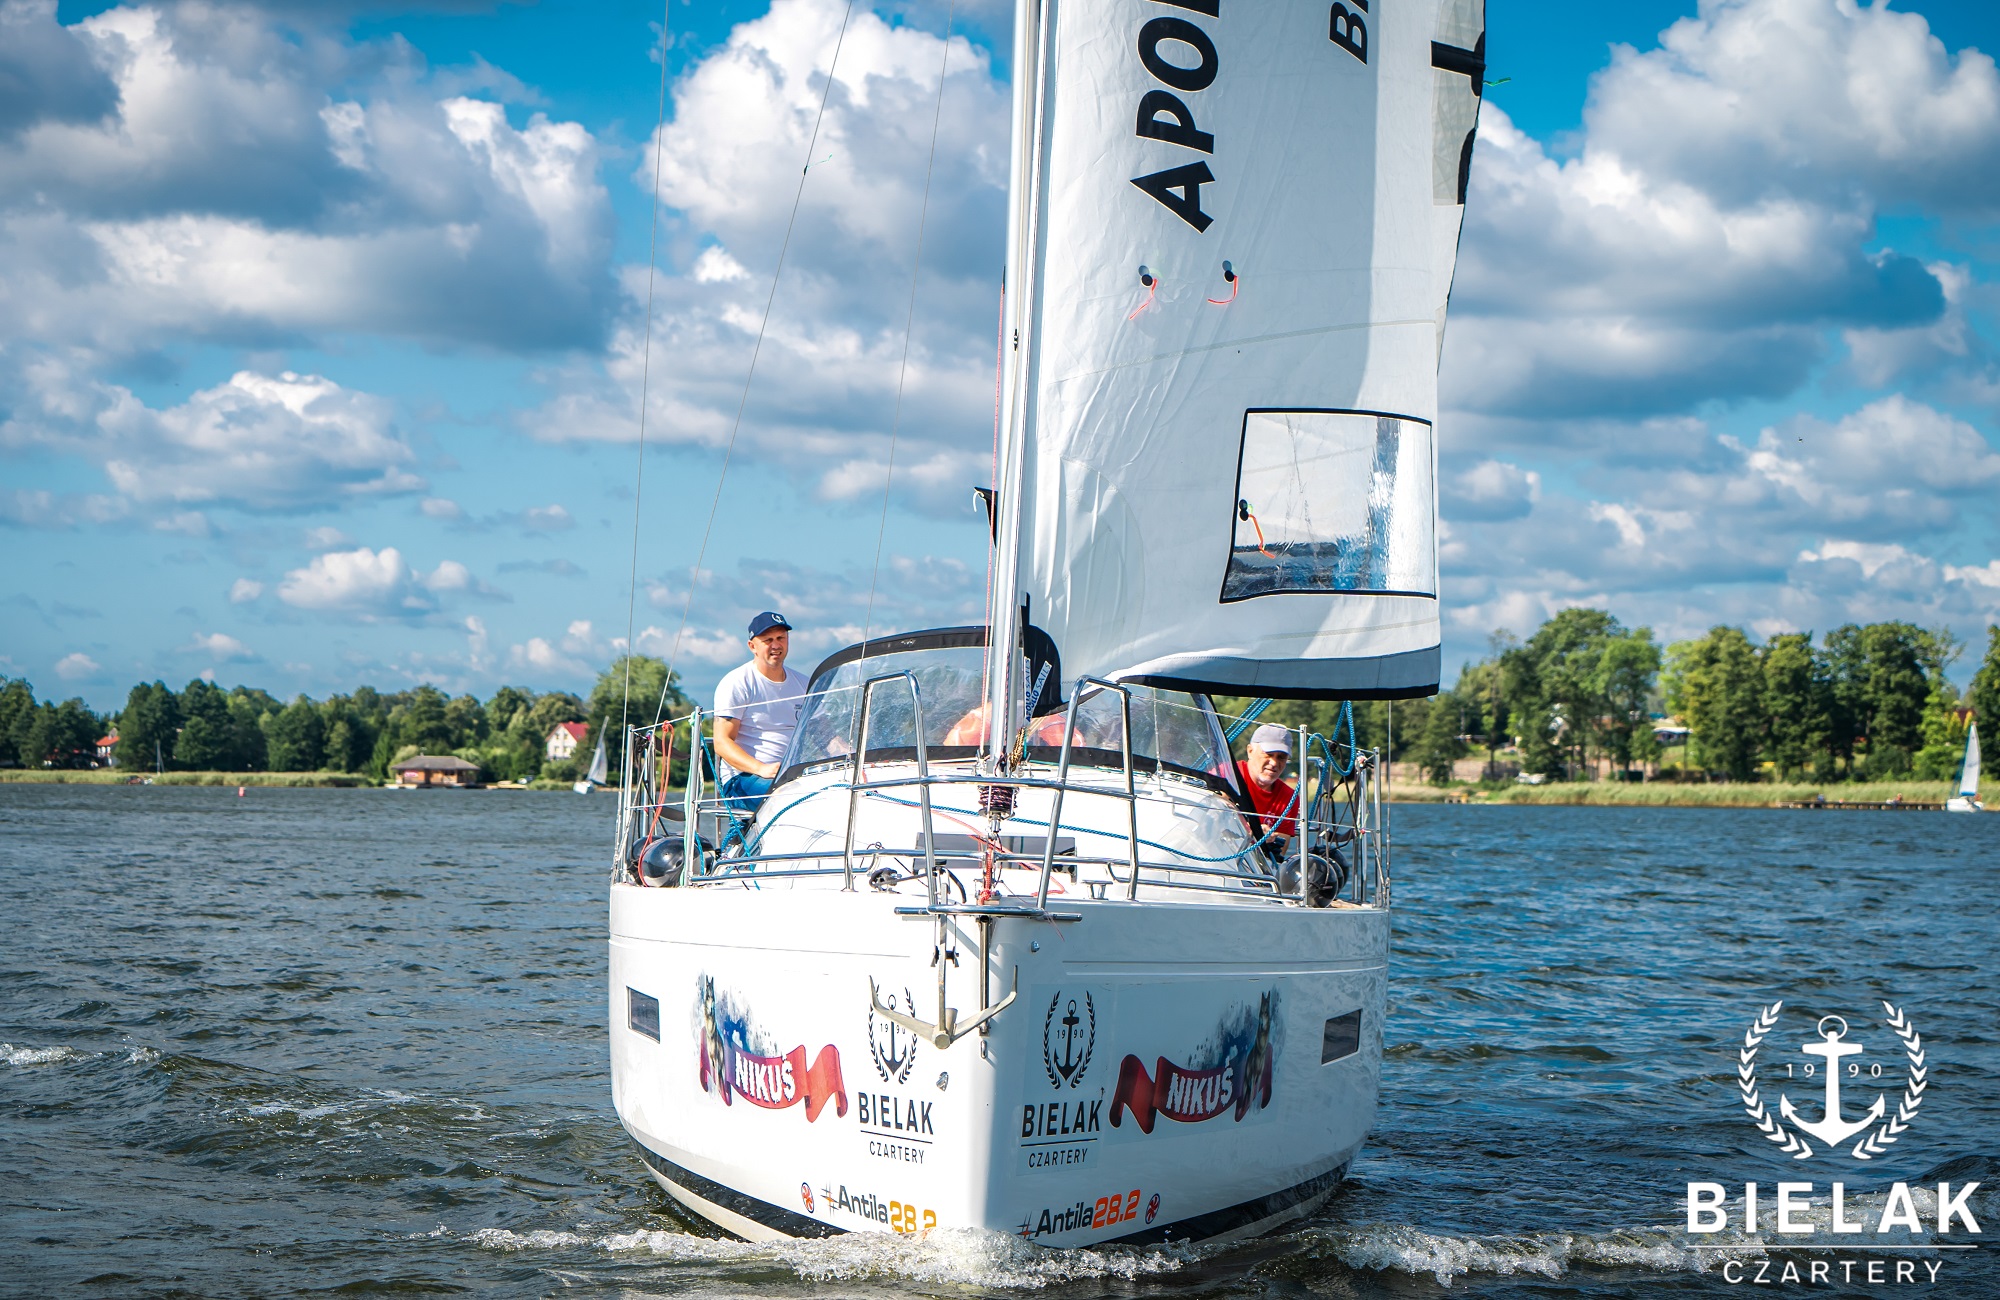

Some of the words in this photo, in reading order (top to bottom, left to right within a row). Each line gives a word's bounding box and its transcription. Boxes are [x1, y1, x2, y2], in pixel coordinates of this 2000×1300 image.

[1328, 0, 1369, 66] B
[1035, 662, 1050, 689] SAILS
[735, 1051, 796, 1104] NIKUŚ
[1165, 1055, 1234, 1116] NIKUŚ
[858, 1091, 934, 1135] BIELAK
[1021, 1100, 1103, 1138] BIELAK
[869, 1140, 925, 1165] CZARTERY
[1028, 1148, 1088, 1168] CZARTERY
